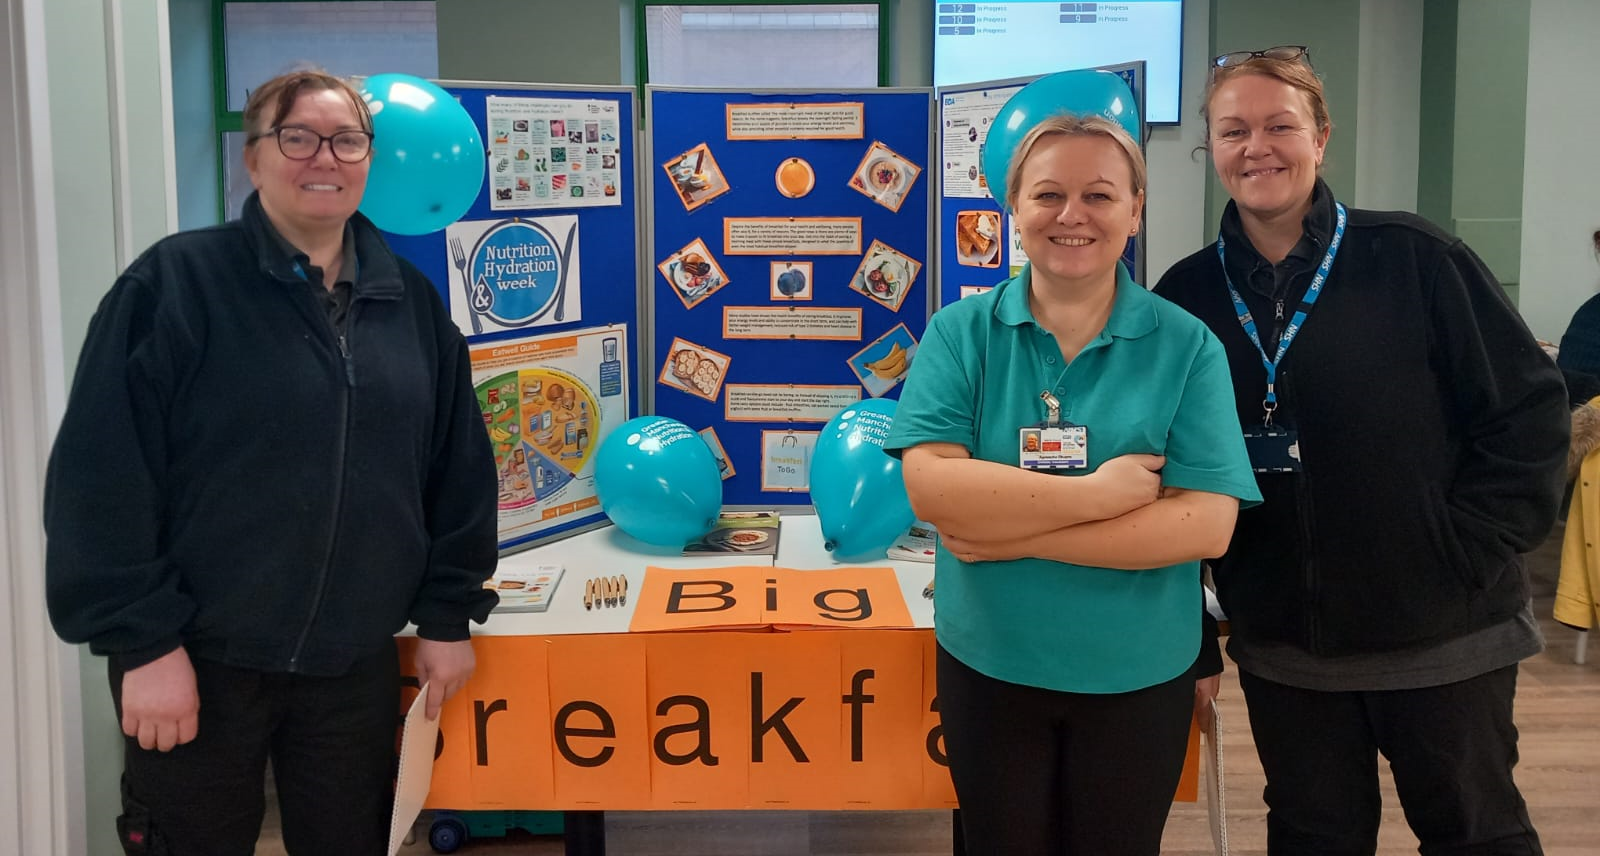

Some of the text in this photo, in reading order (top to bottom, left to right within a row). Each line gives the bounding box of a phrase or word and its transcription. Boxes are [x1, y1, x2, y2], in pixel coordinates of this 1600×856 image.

[952, 4, 962, 12] 12
[1076, 15, 1080, 23] 9
[954, 27, 960, 35] 5
[486, 243, 551, 260] Nutrition
[484, 258, 556, 280] Hydration
[1322, 252, 1333, 271] NHS
[496, 275, 537, 290] week
[1311, 273, 1324, 292] NHS
[475, 285, 489, 308] &
[1284, 324, 1298, 342] NHS
[492, 344, 540, 356] Eatwell Guide
[664, 579, 873, 622] Big
[398, 668, 950, 768] reakf
